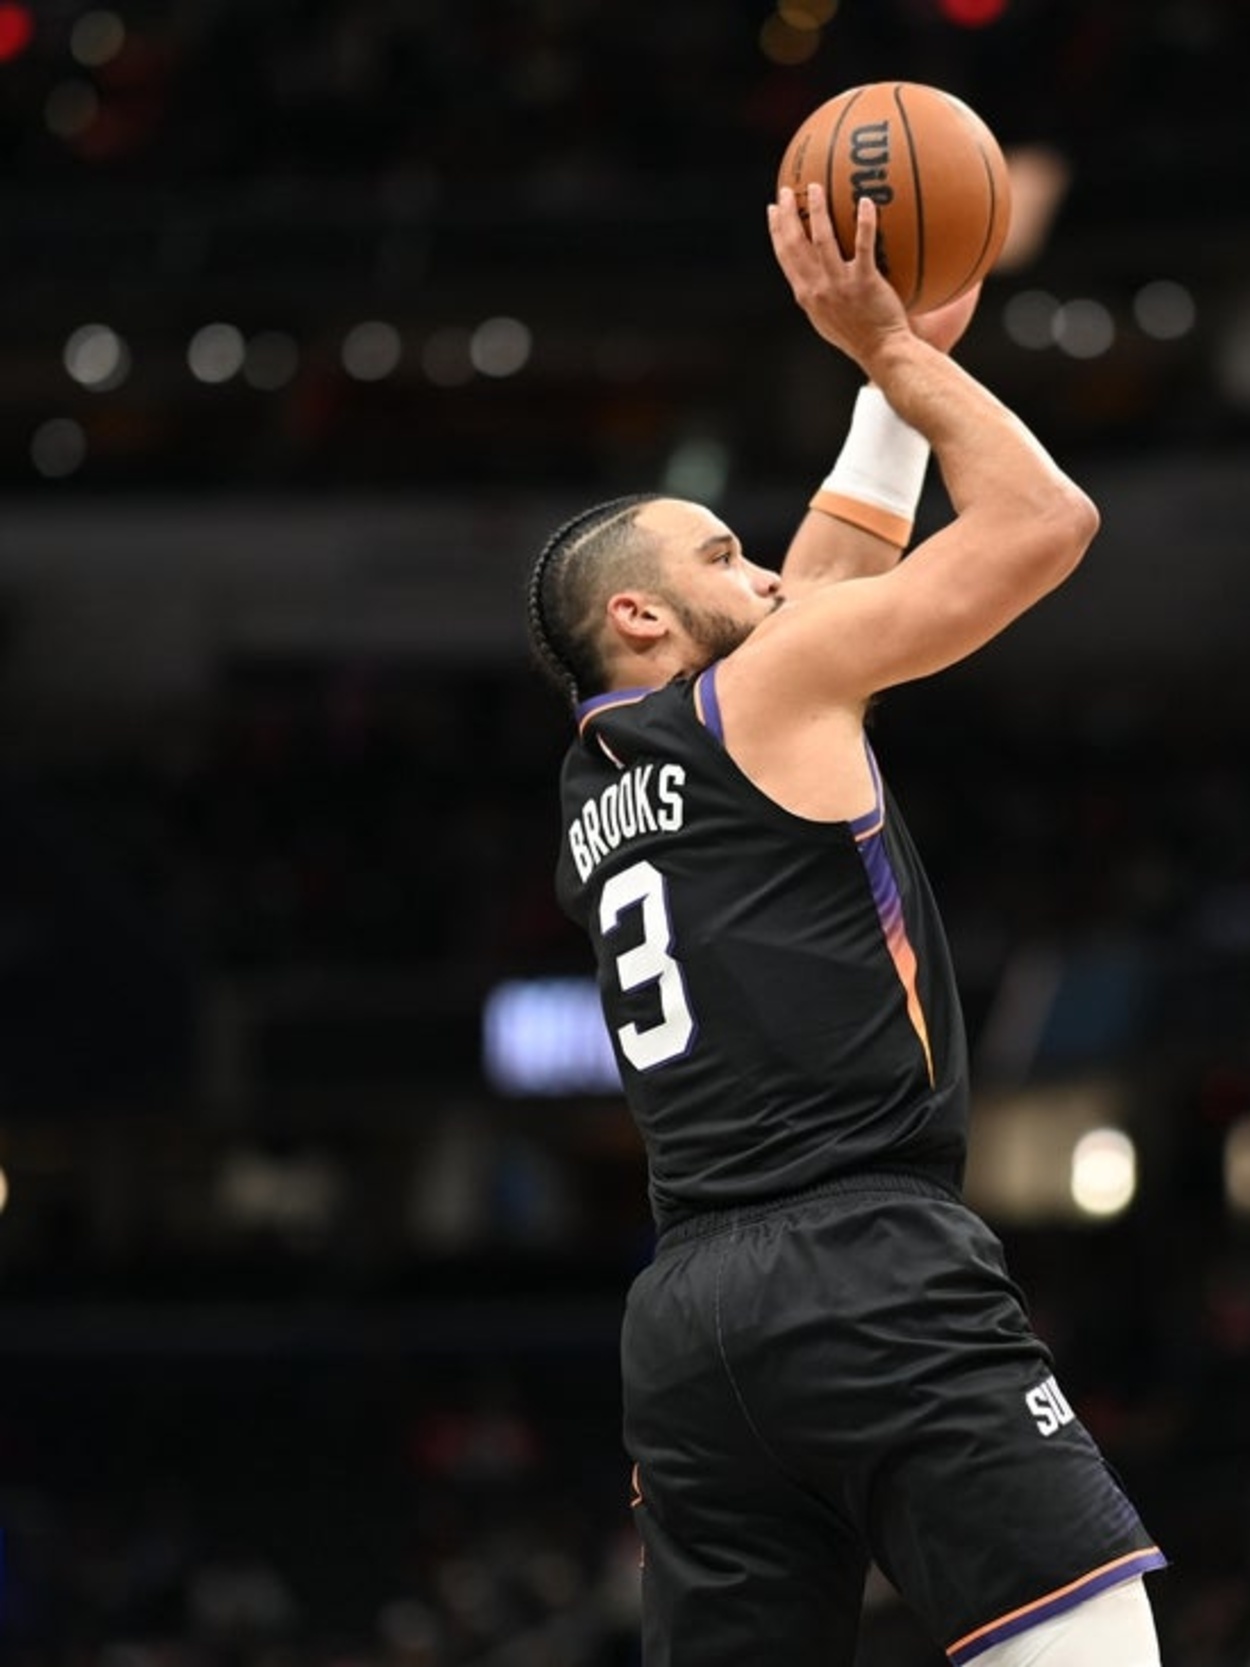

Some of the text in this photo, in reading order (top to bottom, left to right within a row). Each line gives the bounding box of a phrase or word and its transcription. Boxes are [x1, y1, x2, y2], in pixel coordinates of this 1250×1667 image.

[850, 119, 893, 274] Wil
[569, 764, 686, 885] BROOKS
[599, 860, 696, 1072] 3
[1025, 1374, 1076, 1437] SU
